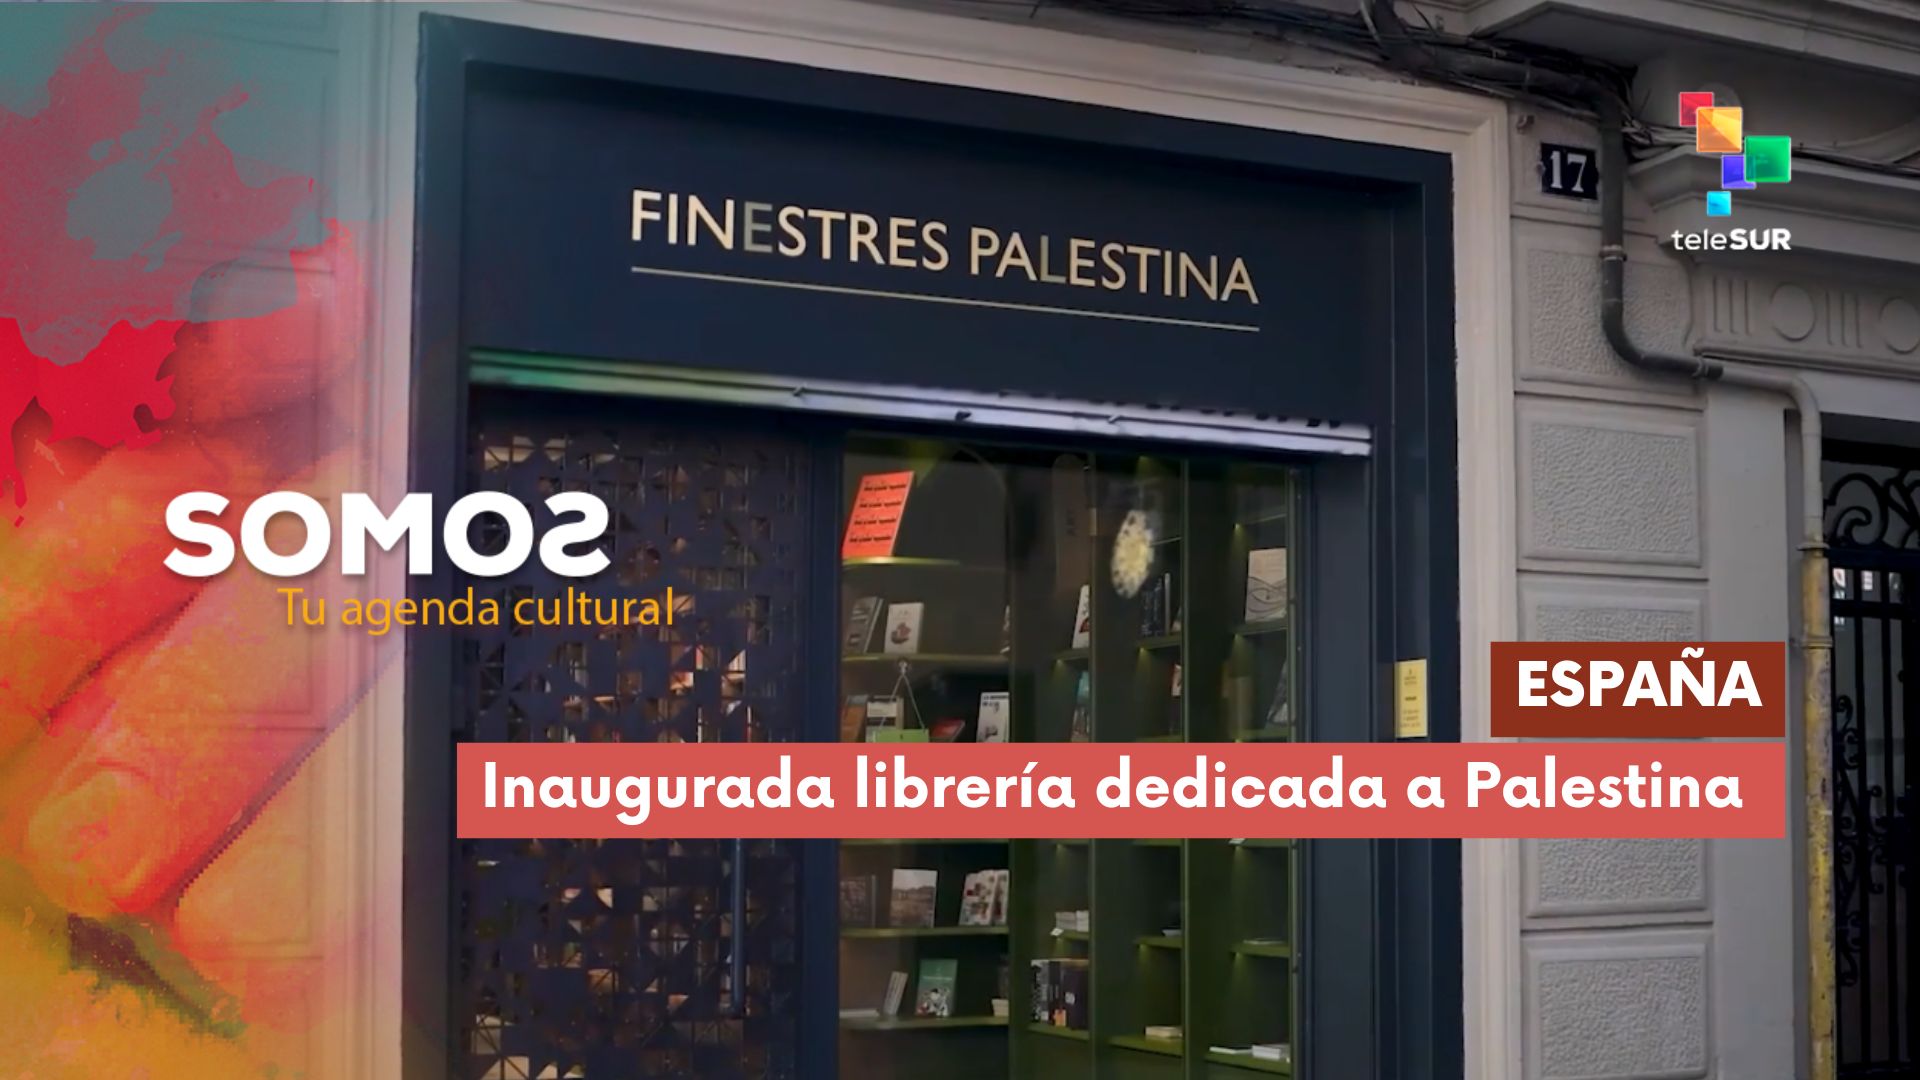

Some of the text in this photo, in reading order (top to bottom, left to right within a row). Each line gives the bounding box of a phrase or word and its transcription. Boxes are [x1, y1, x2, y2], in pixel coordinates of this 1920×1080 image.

[1549, 150, 1588, 194] 17
[630, 188, 1259, 305] FINESTRES PALESTINA
